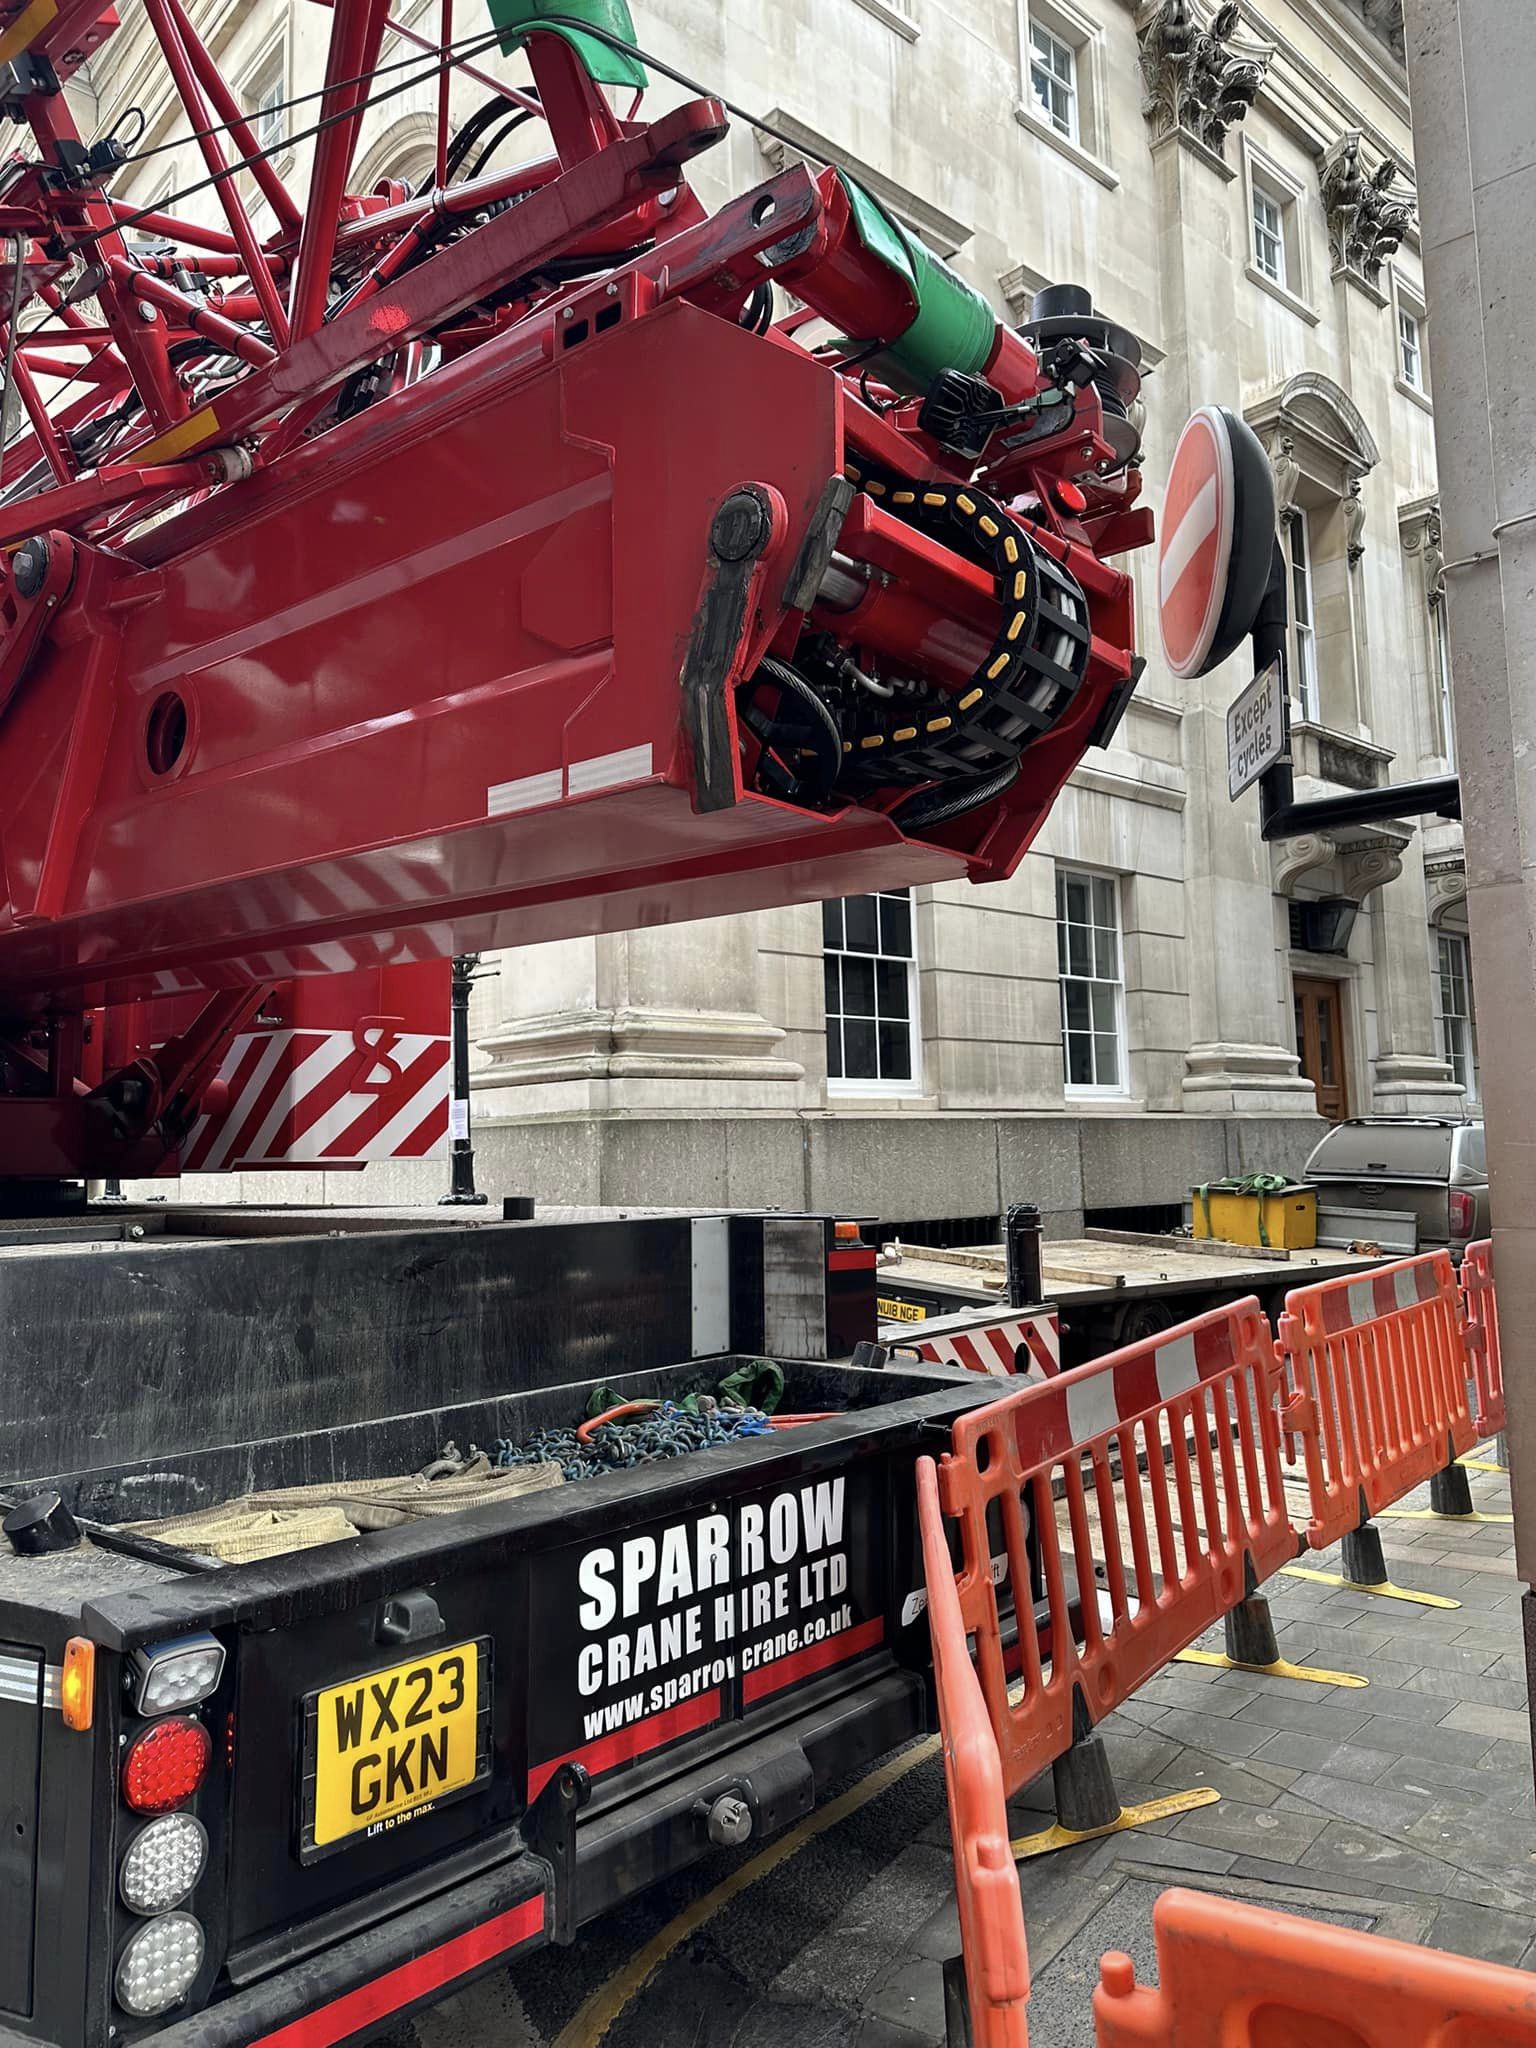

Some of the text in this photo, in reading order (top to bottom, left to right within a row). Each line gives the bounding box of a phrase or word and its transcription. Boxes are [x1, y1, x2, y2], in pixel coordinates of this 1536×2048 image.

[1234, 678, 1273, 744] Except
[1237, 724, 1272, 778] cycles
[899, 1306, 919, 1321] NGE
[578, 1477, 845, 1631] SPARROW
[577, 1553, 847, 1696] CRANE HIRE LTD
[335, 1656, 465, 1753] WX23
[351, 1726, 449, 1816] GKN
[367, 1802, 435, 1837] Lift to the max.
